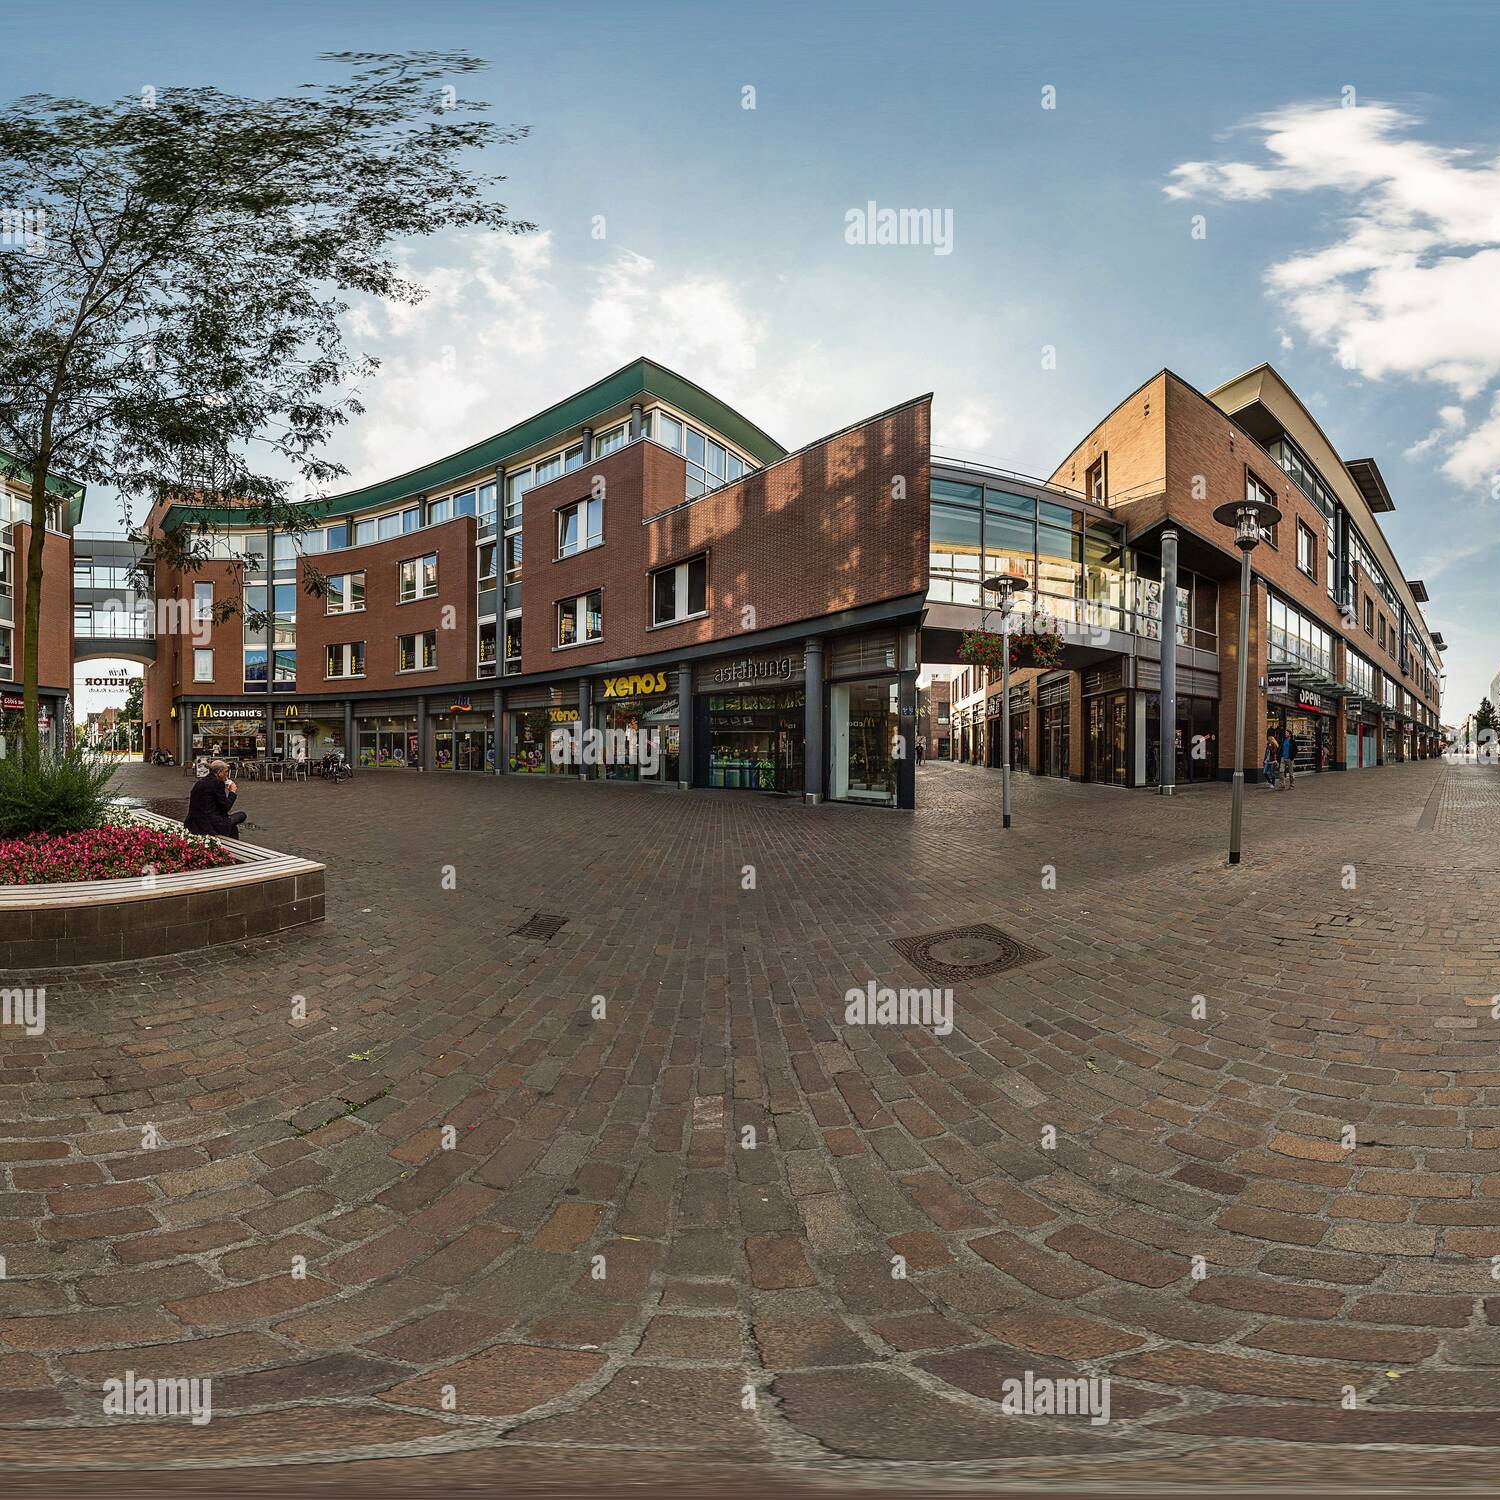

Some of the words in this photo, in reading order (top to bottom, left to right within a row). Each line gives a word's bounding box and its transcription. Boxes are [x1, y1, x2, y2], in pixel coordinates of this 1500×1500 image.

[714, 658, 792, 683] asiahung
[603, 672, 667, 698] xenos
[196, 704, 262, 718] McDonald's
